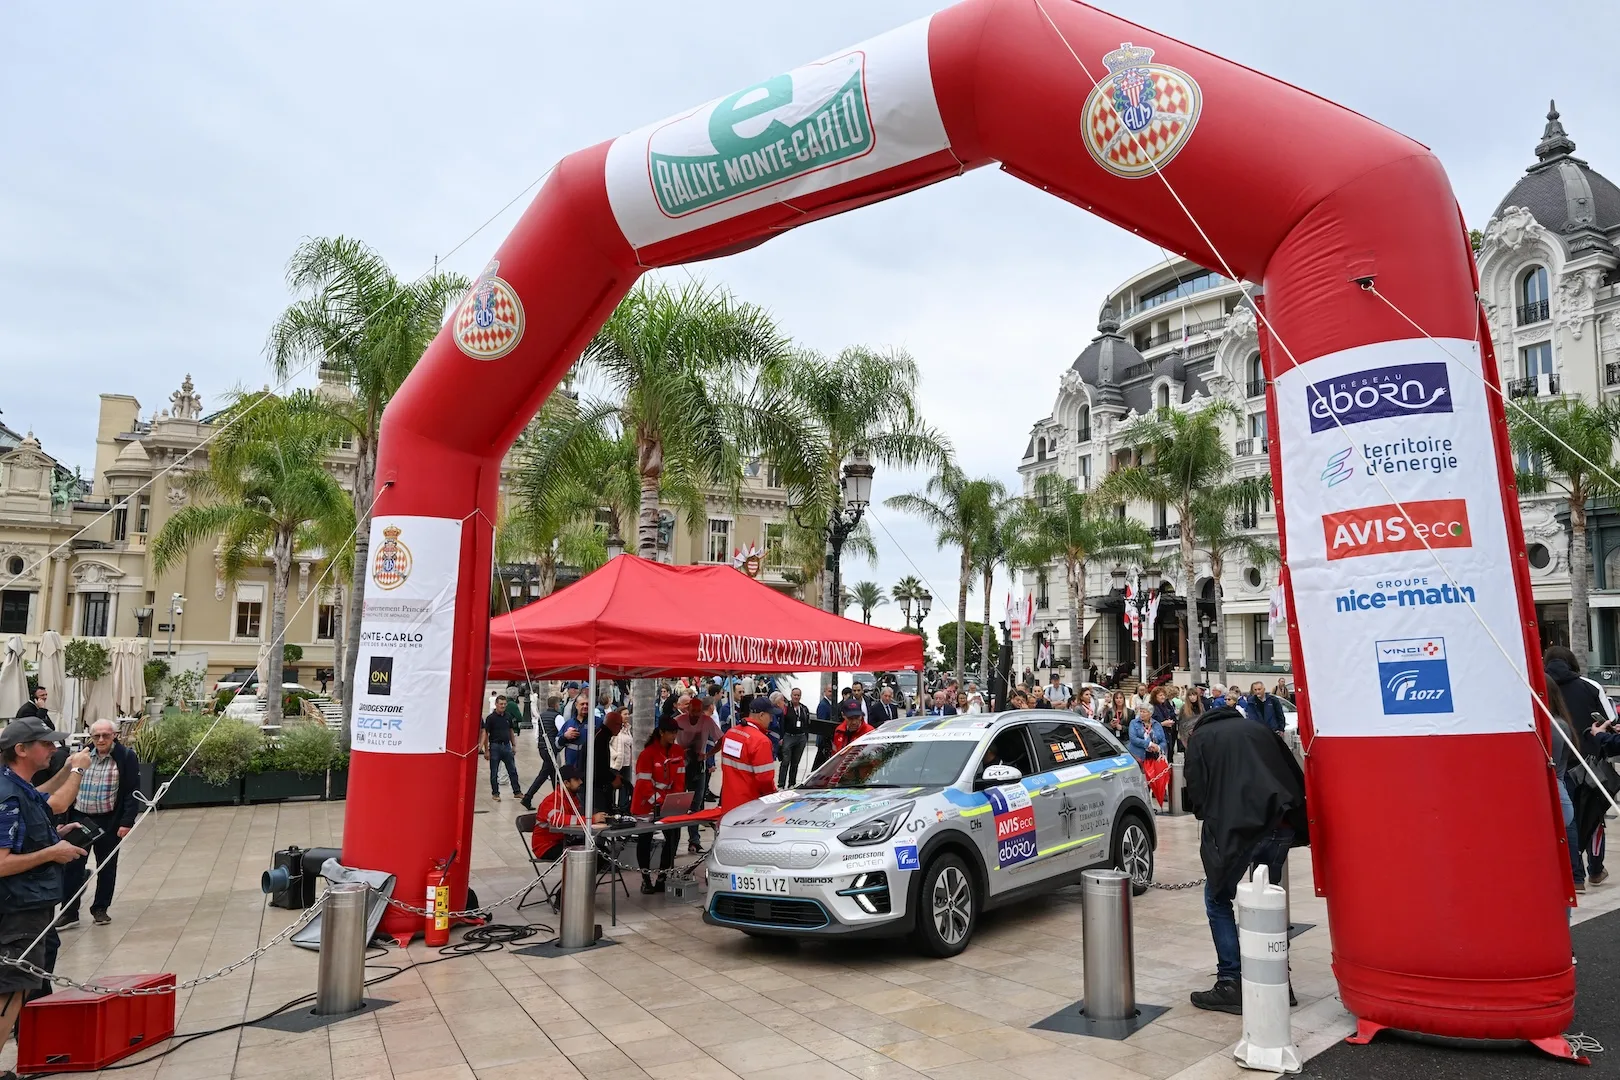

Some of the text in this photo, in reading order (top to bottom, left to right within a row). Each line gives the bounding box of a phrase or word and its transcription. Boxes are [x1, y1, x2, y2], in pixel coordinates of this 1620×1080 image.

[656, 88, 864, 209] RALLYE MONTE-CARLO
[1341, 373, 1402, 389] RÉSEAU
[1364, 437, 1453, 459] territoire
[1332, 516, 1463, 550] AVIS eco
[1376, 577, 1429, 589] GROUPE
[1336, 580, 1476, 613] nice-matin
[697, 633, 862, 667] AUTOMOBILE CLUB DE MONACO
[1383, 647, 1421, 655] VINCI
[1409, 689, 1445, 701] 107.7
[359, 703, 404, 713] BRIDGESTONE
[785, 817, 837, 829] blendio
[998, 816, 1020, 837] AVIS
[842, 851, 885, 861] BRIDGESTONE
[737, 876, 787, 892] 3951 LYZ
